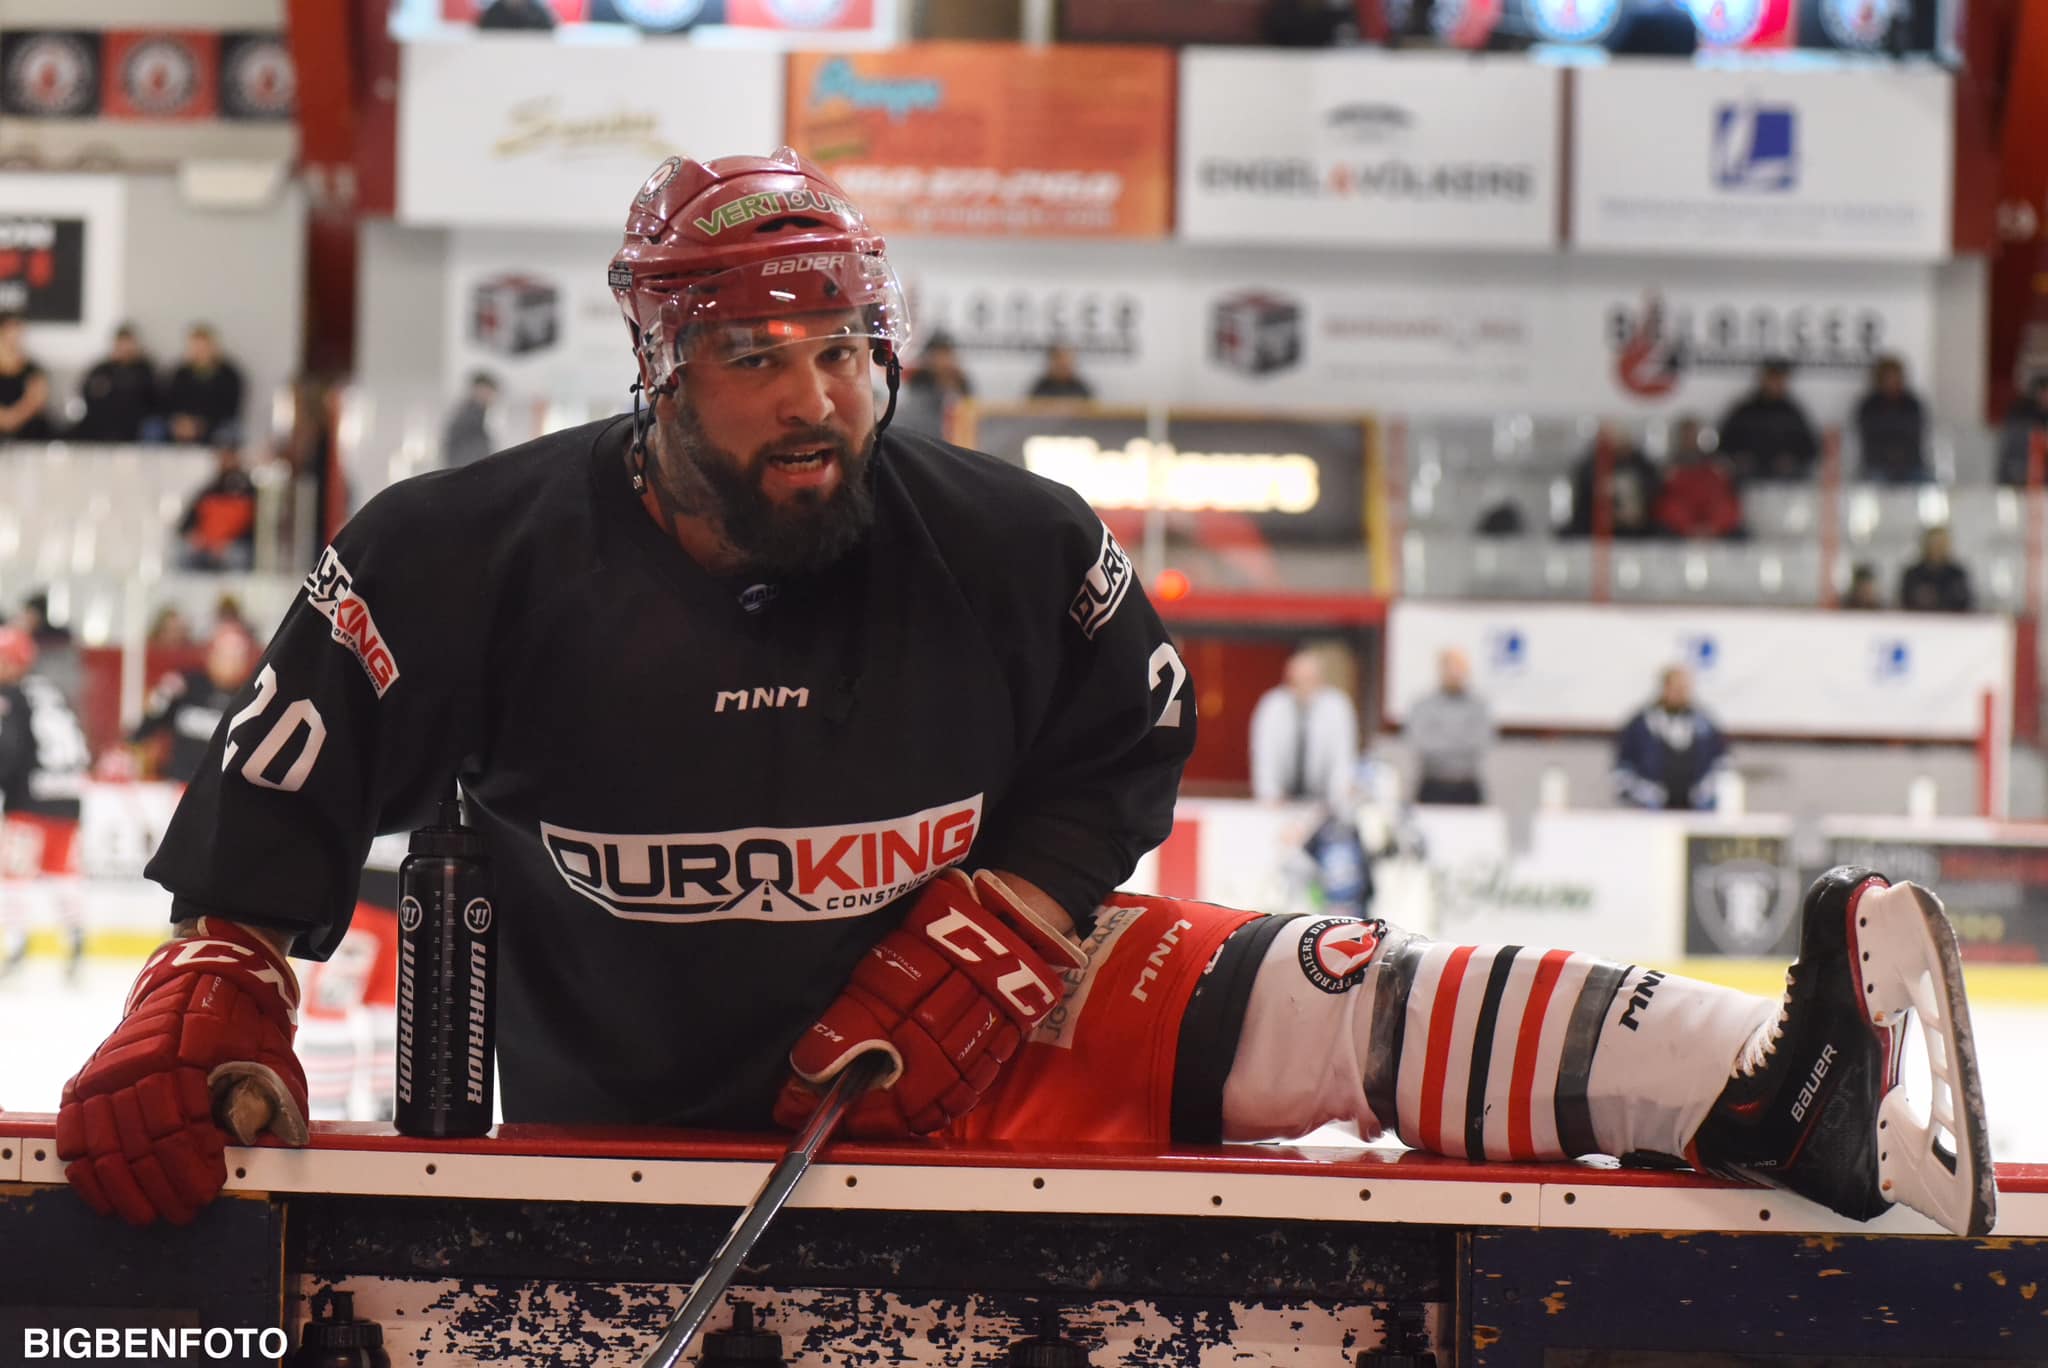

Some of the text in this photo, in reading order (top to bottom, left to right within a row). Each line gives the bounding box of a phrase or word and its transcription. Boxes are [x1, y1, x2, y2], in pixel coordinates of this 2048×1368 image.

[221, 662, 327, 792] 20
[714, 686, 809, 713] MNM
[547, 808, 976, 899] DUROKING
[1131, 919, 1192, 1003] MNM
[1619, 970, 1666, 1031] MN
[400, 938, 416, 1104] WARRIOR
[466, 940, 487, 1105] WARRIOR
